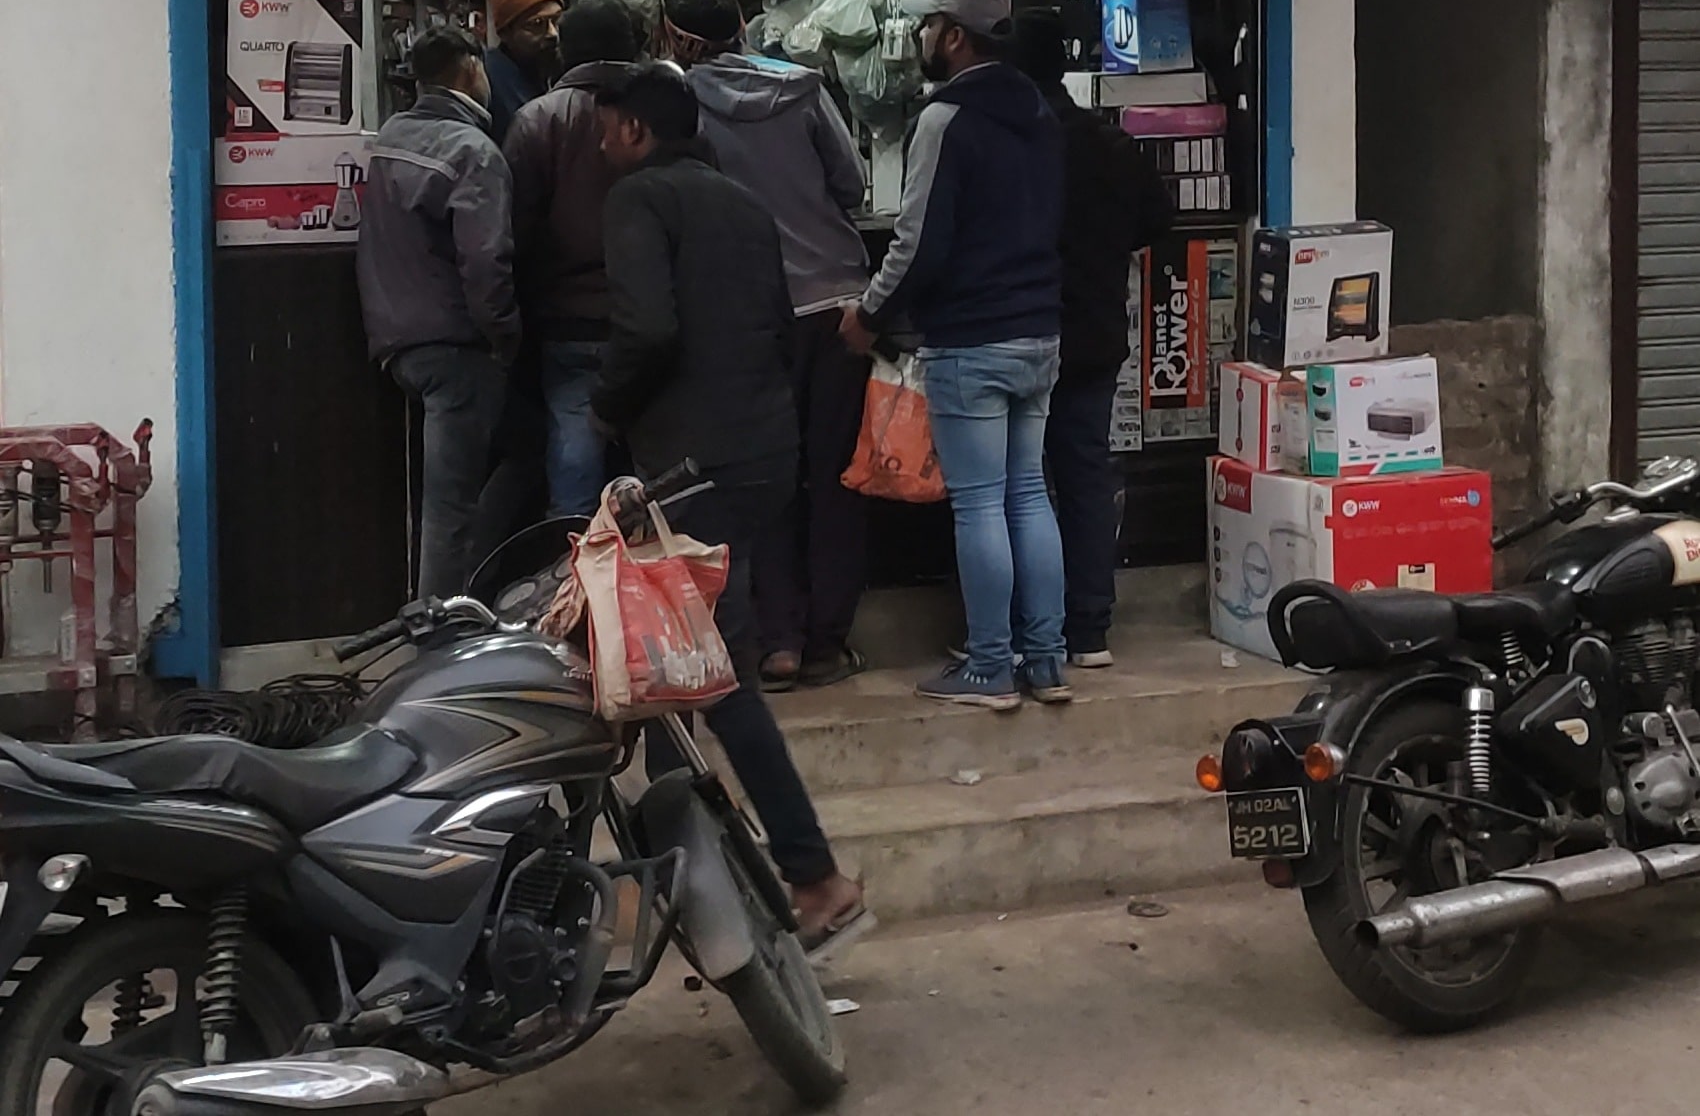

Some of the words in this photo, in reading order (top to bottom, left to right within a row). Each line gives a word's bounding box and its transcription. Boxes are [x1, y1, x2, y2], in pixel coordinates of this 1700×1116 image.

[261, 1, 290, 13] KWW
[240, 41, 285, 52] QUARTO
[248, 148, 275, 158] KWW
[1358, 500, 1381, 512] KWW
[1233, 823, 1299, 849] 5212
